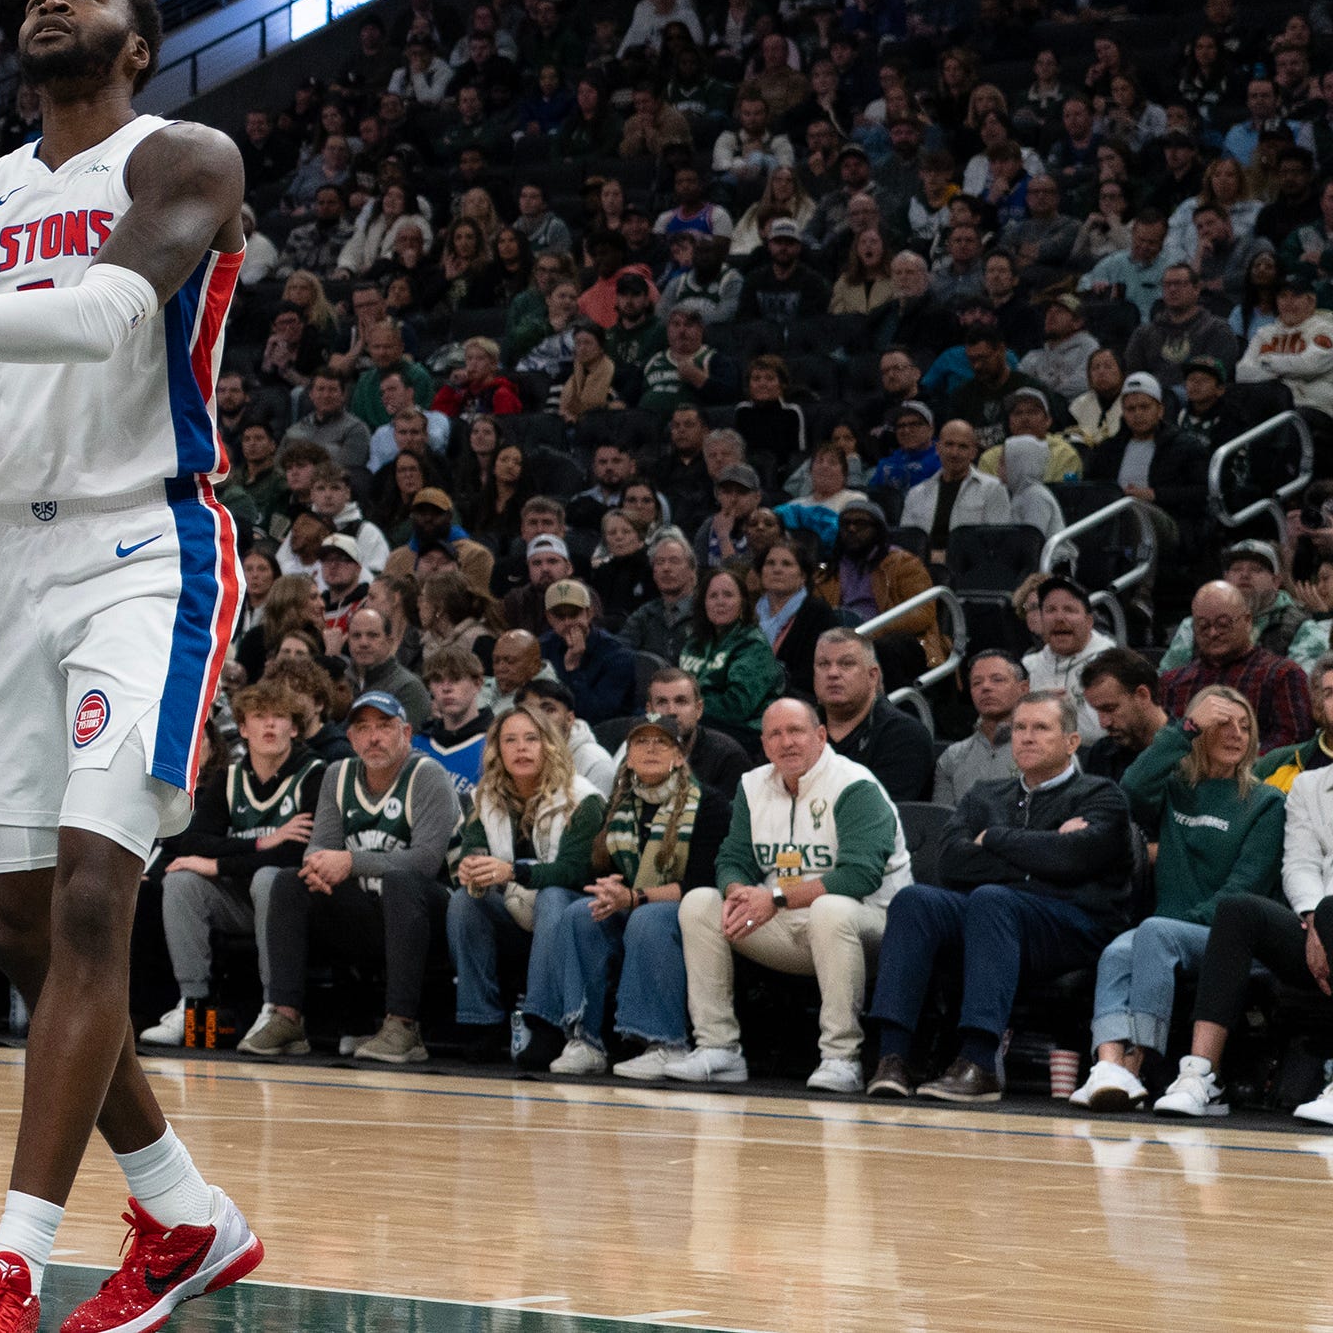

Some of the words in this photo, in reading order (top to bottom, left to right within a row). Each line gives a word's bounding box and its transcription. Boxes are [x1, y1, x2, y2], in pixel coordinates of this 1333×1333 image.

[79, 707, 102, 722] DETROIT
[77, 717, 101, 730] PISTONS
[754, 842, 832, 870] BUKS
